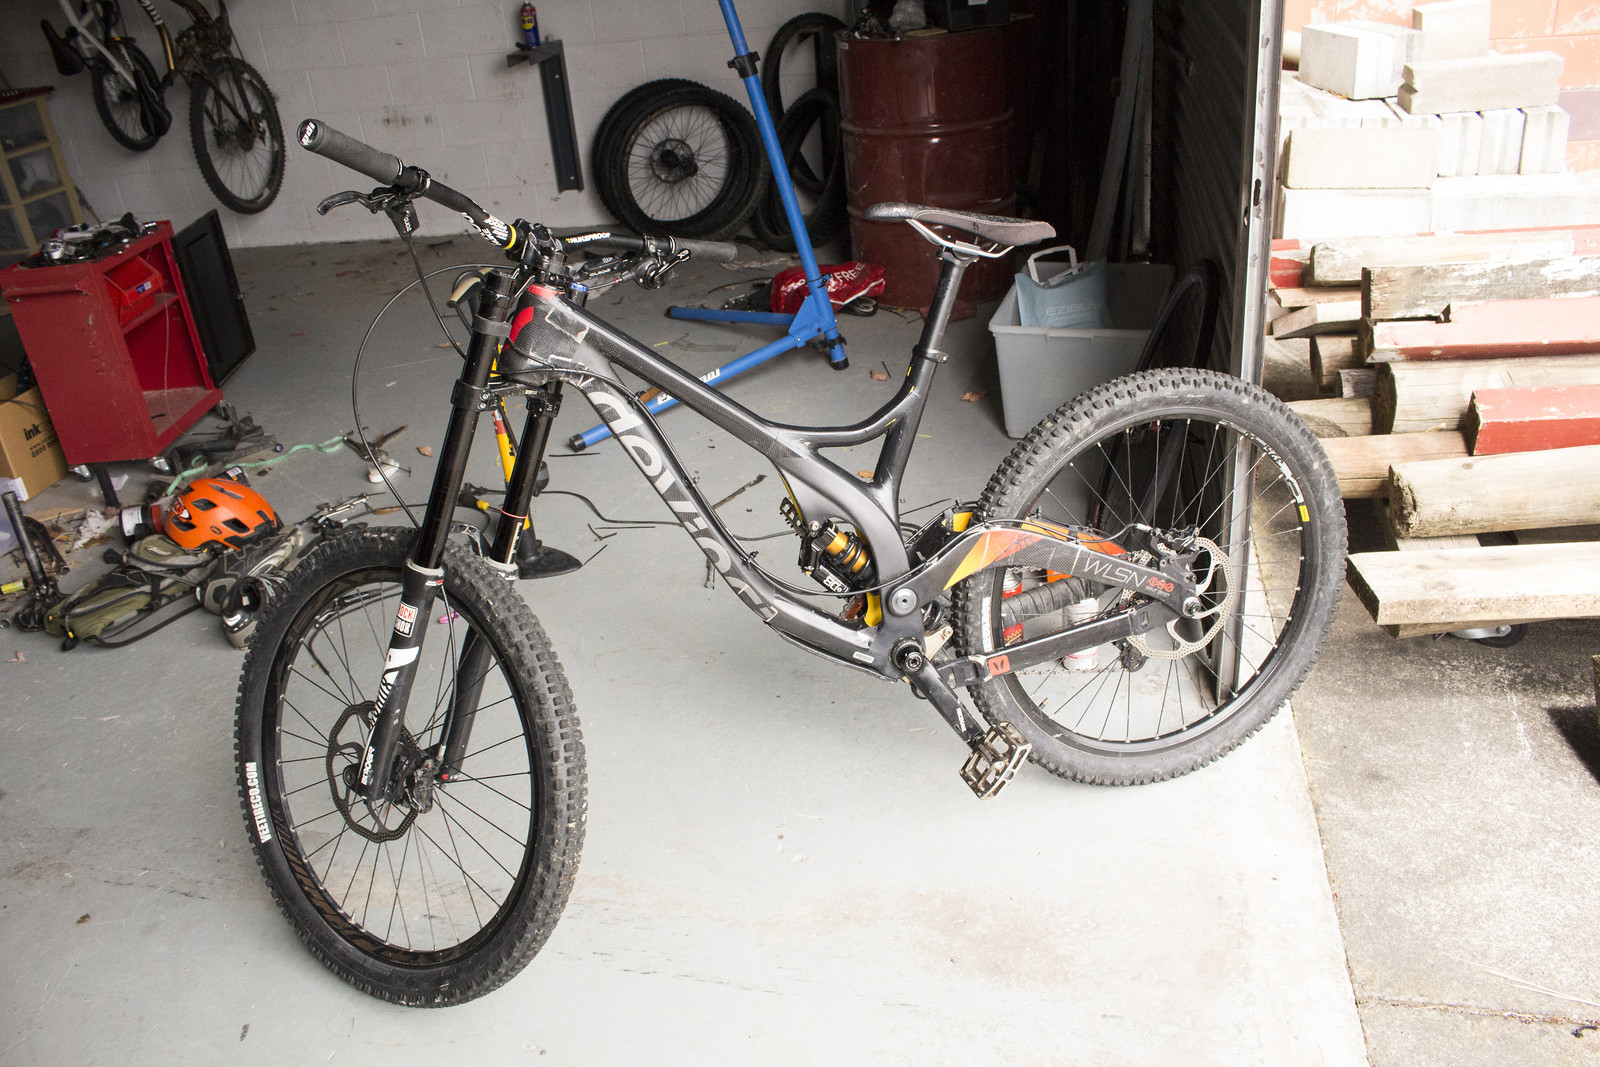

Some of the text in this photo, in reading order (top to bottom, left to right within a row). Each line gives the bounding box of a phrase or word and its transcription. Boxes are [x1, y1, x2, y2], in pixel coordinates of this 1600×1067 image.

[834, 262, 865, 283] FREE
[23, 423, 42, 441] ink
[1084, 557, 1148, 587] WLSN
[245, 761, 272, 844] VEETIRECO.COM
